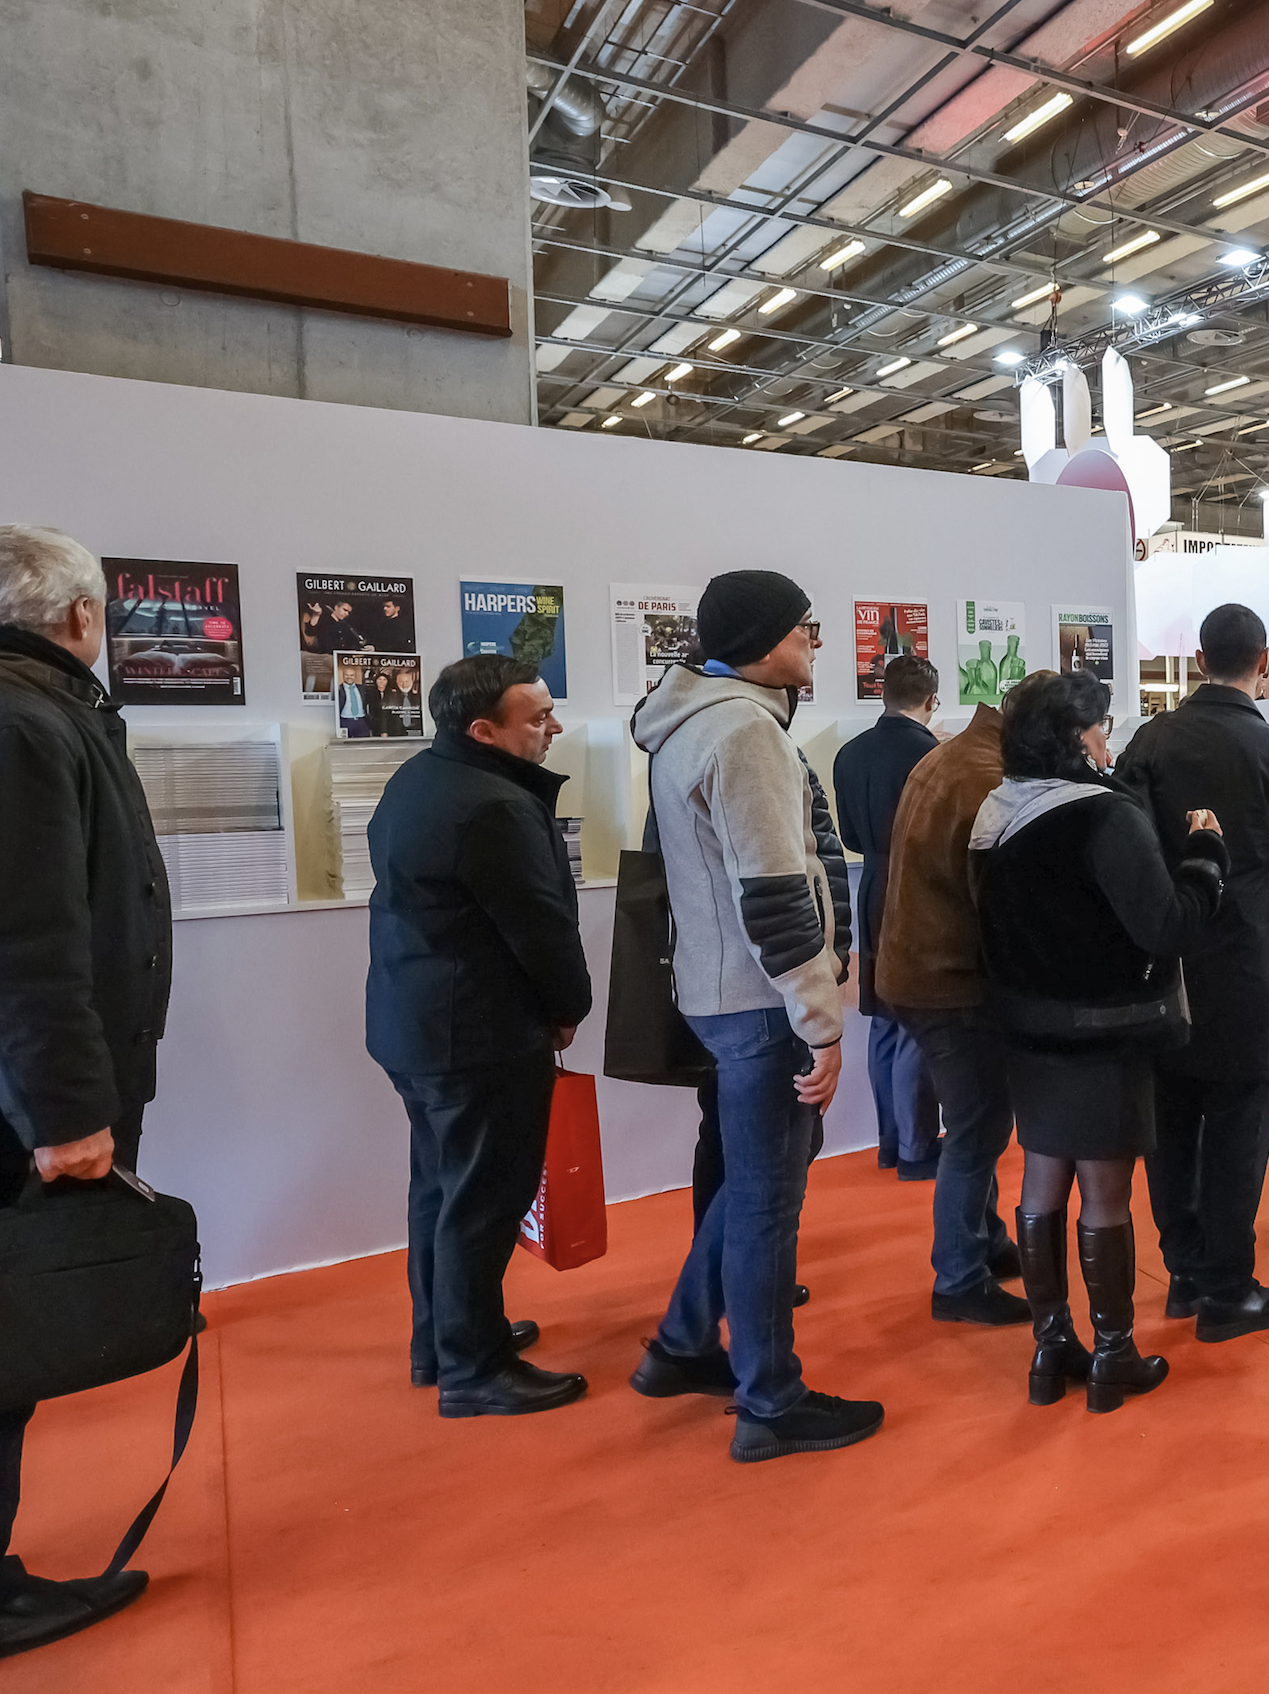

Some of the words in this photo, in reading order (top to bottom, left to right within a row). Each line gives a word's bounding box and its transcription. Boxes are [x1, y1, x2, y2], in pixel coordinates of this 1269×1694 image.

[118, 573, 229, 603] falstaff
[304, 578, 344, 590] GILBERT
[358, 581, 406, 594] GAILLARD
[464, 592, 536, 613] HARPERS
[536, 596, 554, 604] WINE
[537, 605, 560, 614] SPIRIT
[638, 601, 649, 610] DE
[652, 602, 676, 611] PARIS
[857, 610, 879, 620] vin
[343, 657, 372, 666] GILBERT
[380, 658, 416, 667] GAILLARD
